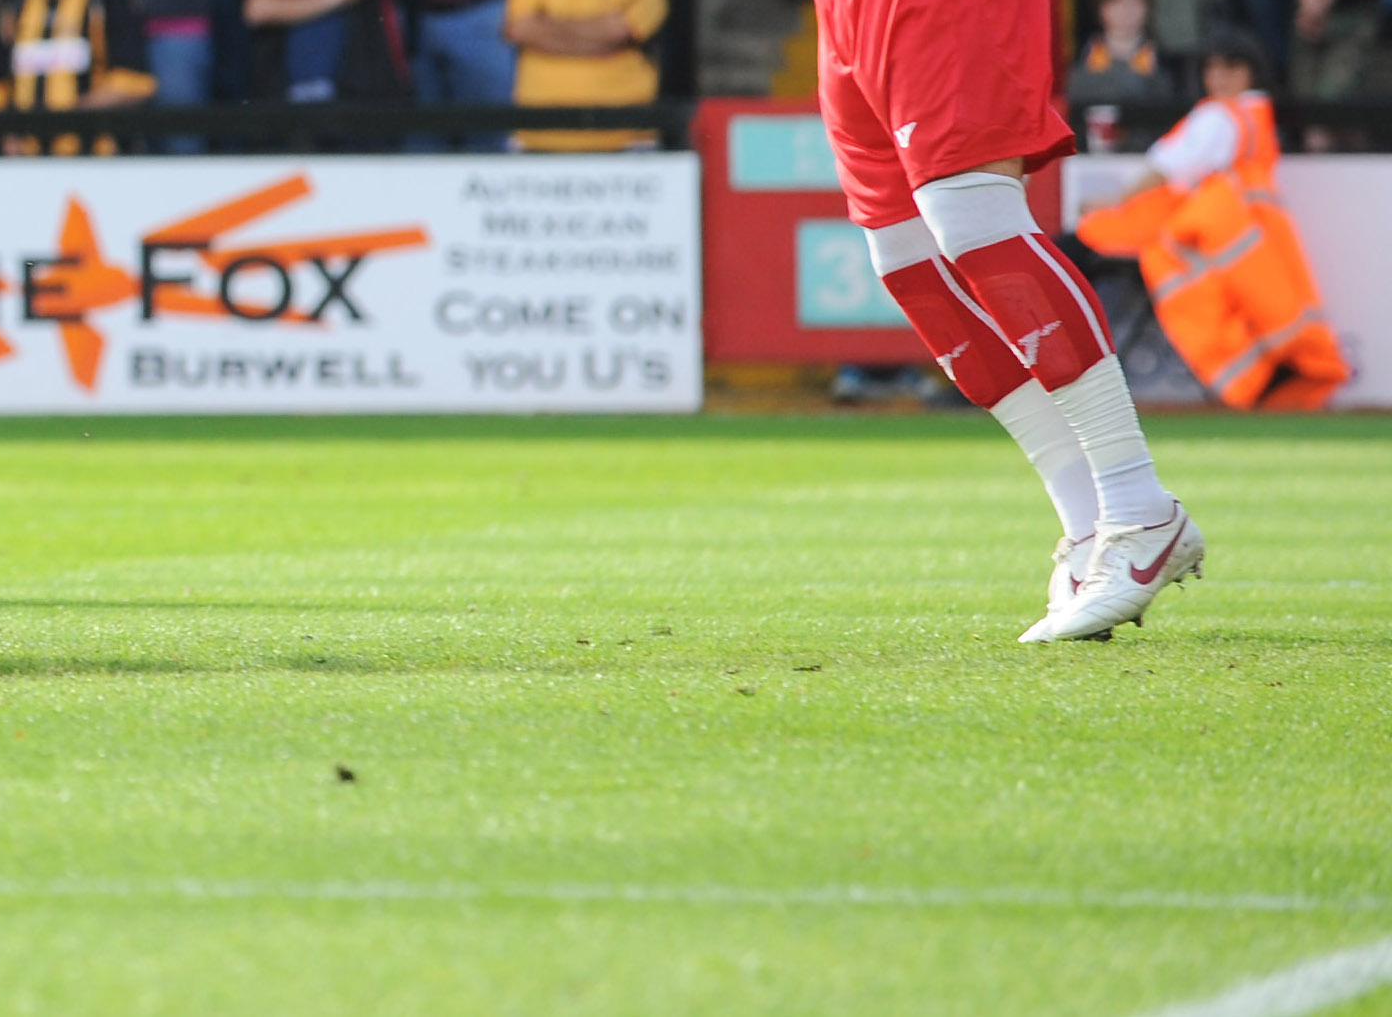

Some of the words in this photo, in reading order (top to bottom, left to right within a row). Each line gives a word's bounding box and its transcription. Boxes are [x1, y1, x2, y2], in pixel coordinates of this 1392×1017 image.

[464, 175, 661, 201] AUTHENTIC
[435, 290, 593, 335] COME
[609, 294, 686, 335] ON
[130, 346, 420, 390] BURWELL
[465, 351, 565, 390] YOU
